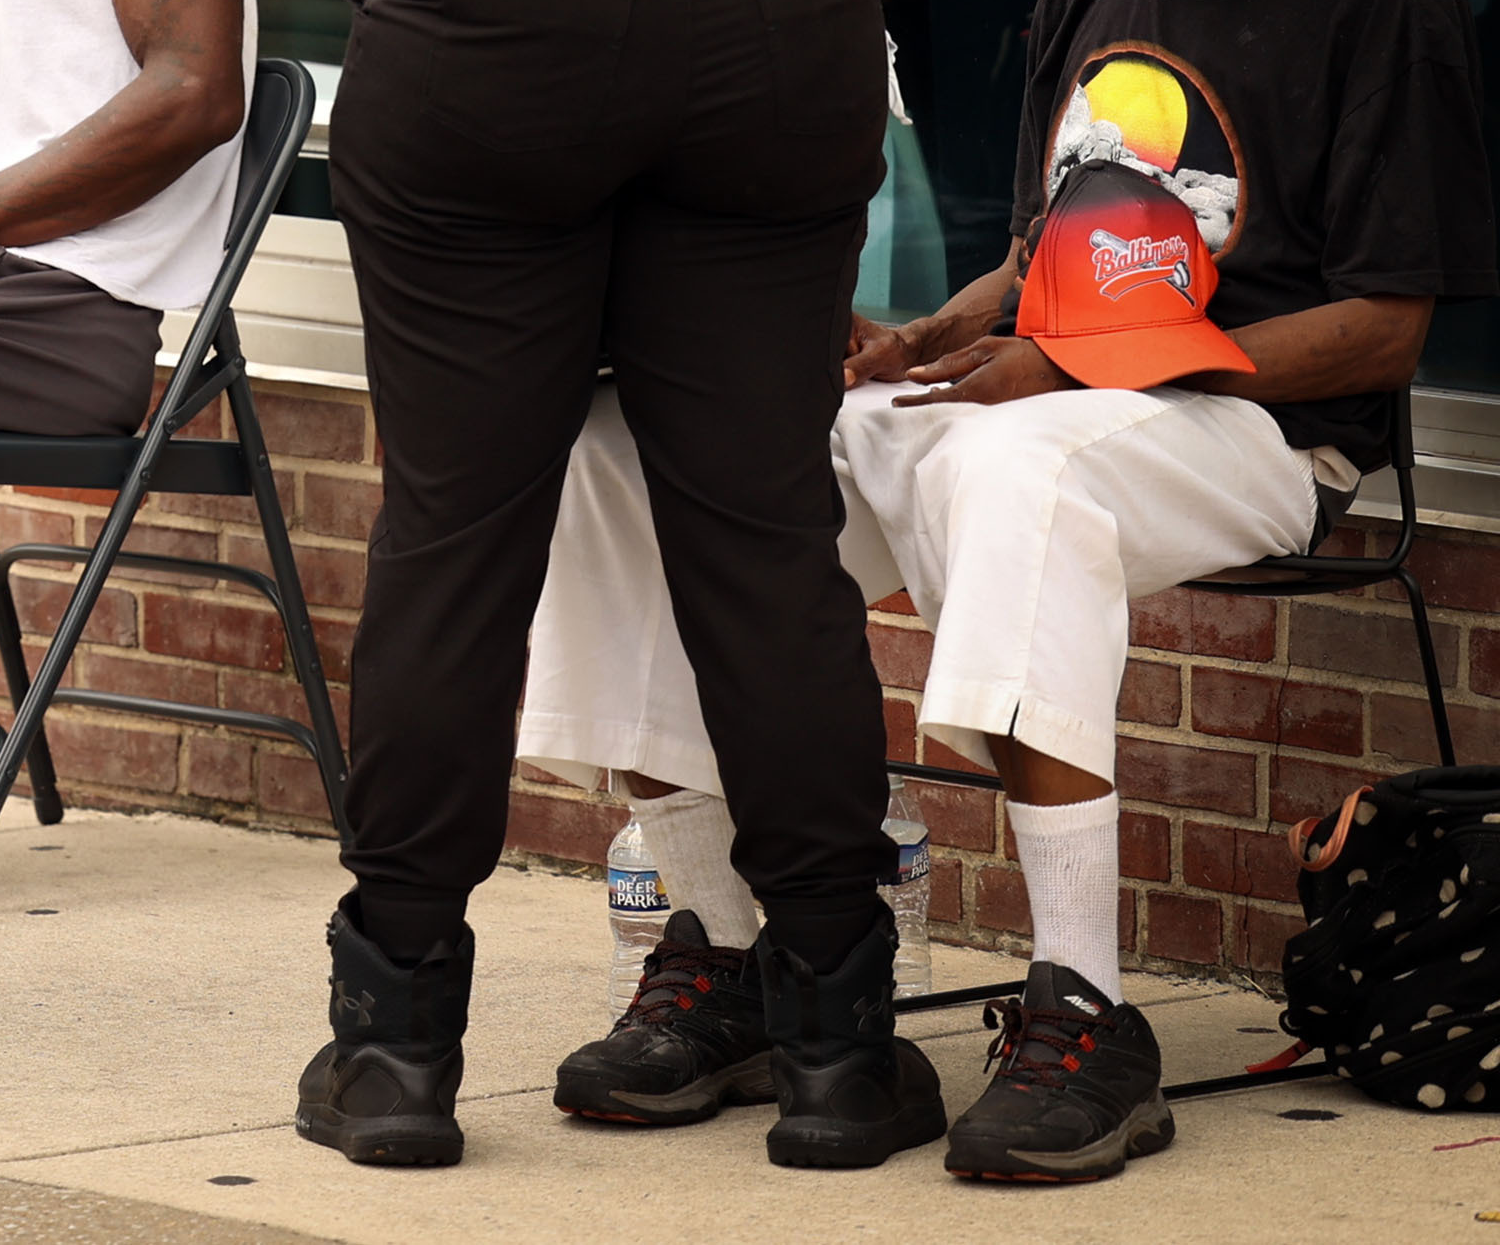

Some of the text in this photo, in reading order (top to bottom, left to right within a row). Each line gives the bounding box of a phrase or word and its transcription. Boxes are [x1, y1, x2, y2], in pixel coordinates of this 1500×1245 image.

[1092, 235, 1188, 281] Baltimore
[910, 860, 929, 879] PAR
[617, 879, 656, 894] DEER
[617, 892, 658, 909] PARK
